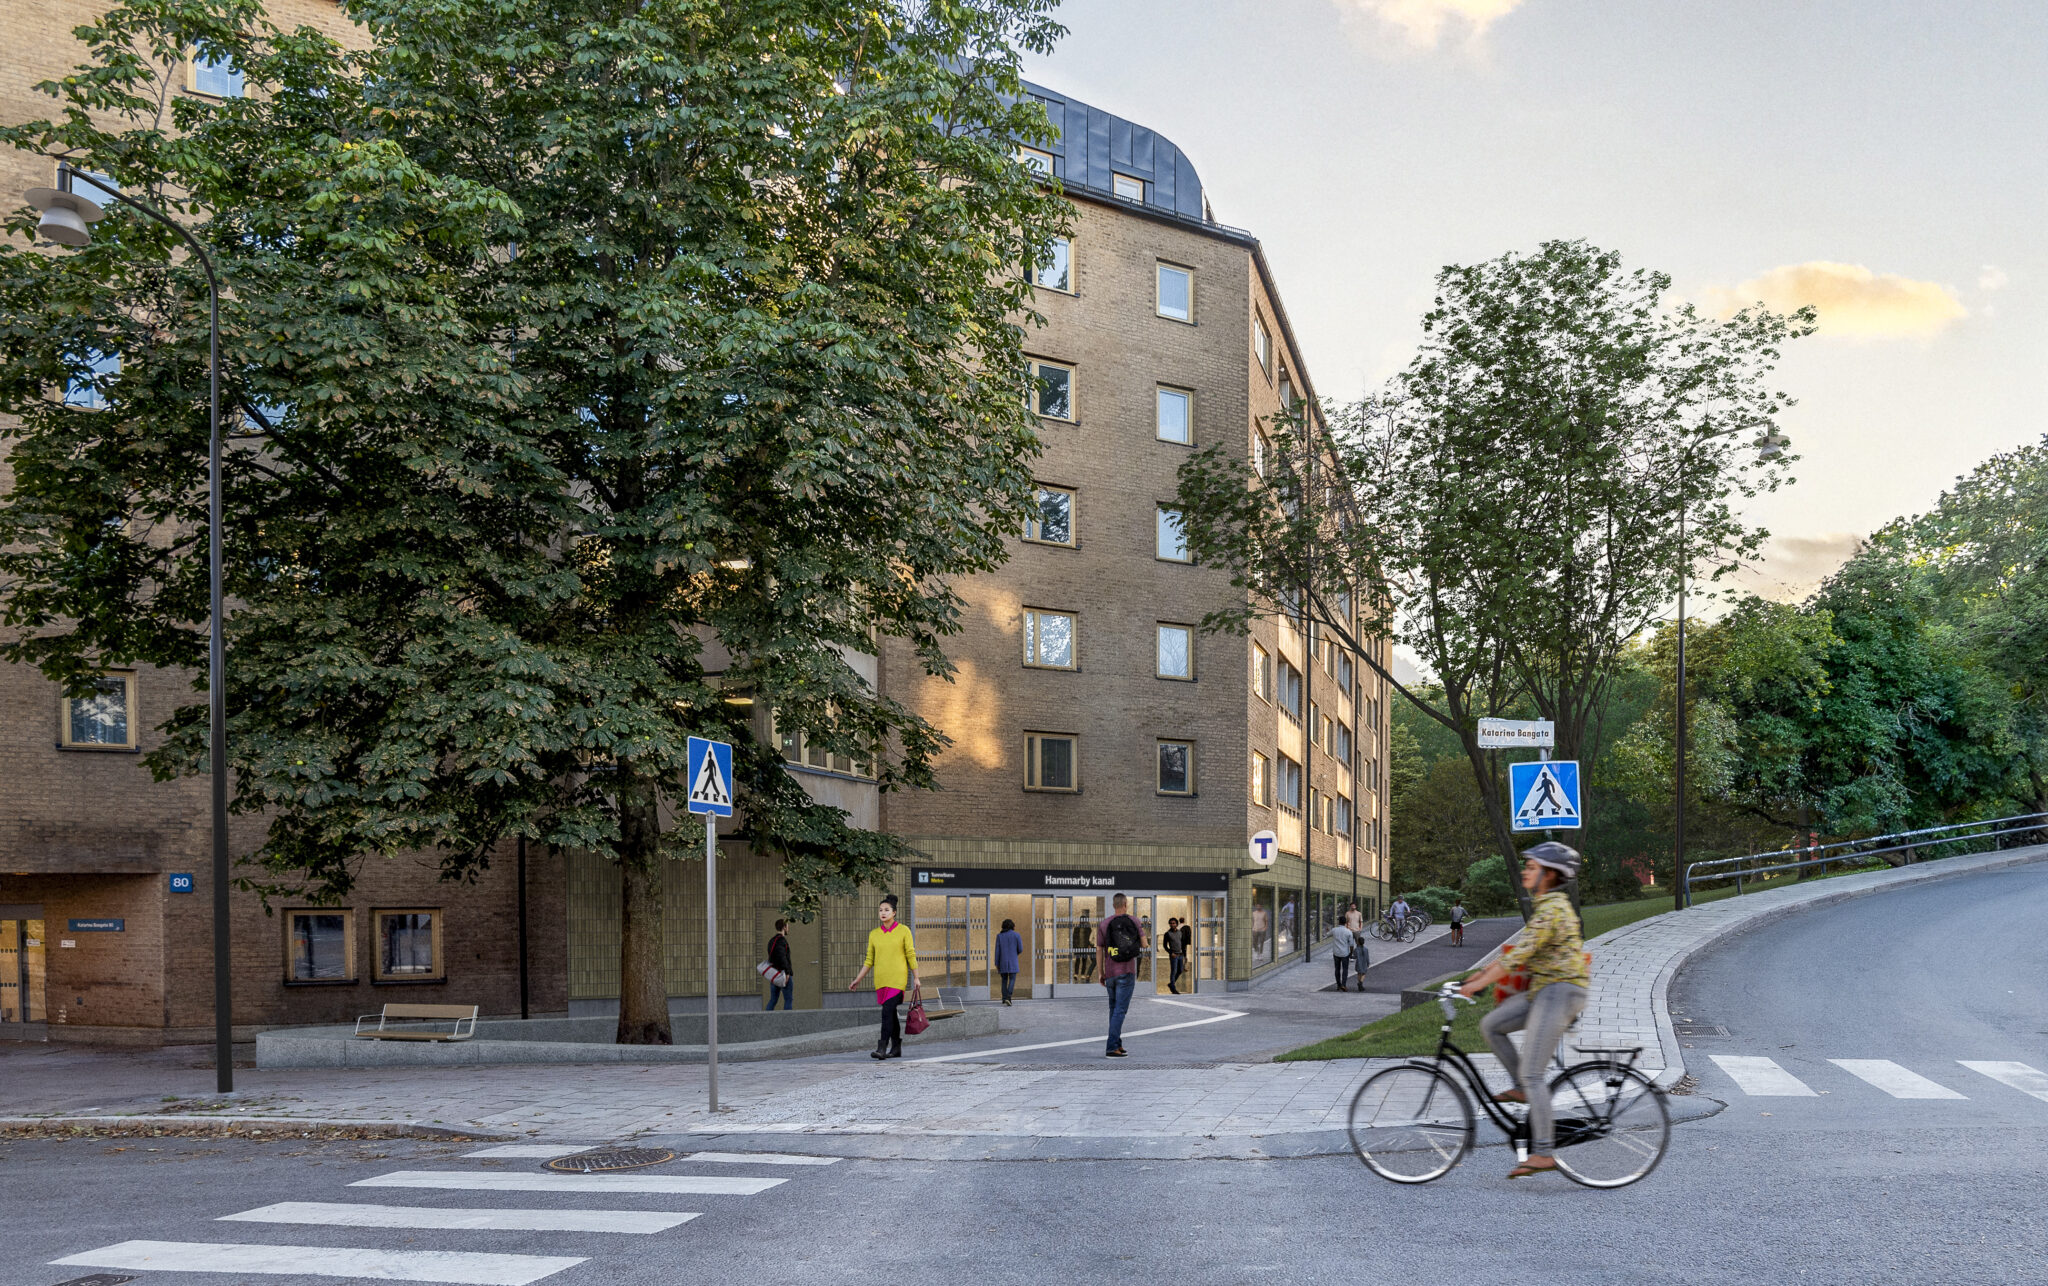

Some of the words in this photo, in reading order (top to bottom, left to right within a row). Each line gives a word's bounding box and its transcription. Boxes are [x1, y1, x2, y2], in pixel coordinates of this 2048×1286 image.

[1481, 728, 1516, 737] Katarina
[1517, 728, 1549, 739] Bangata
[1254, 837, 1273, 859] T
[173, 877, 189, 888] 80
[1045, 875, 1090, 887] Hammarby
[1092, 876, 1115, 886] kanal
